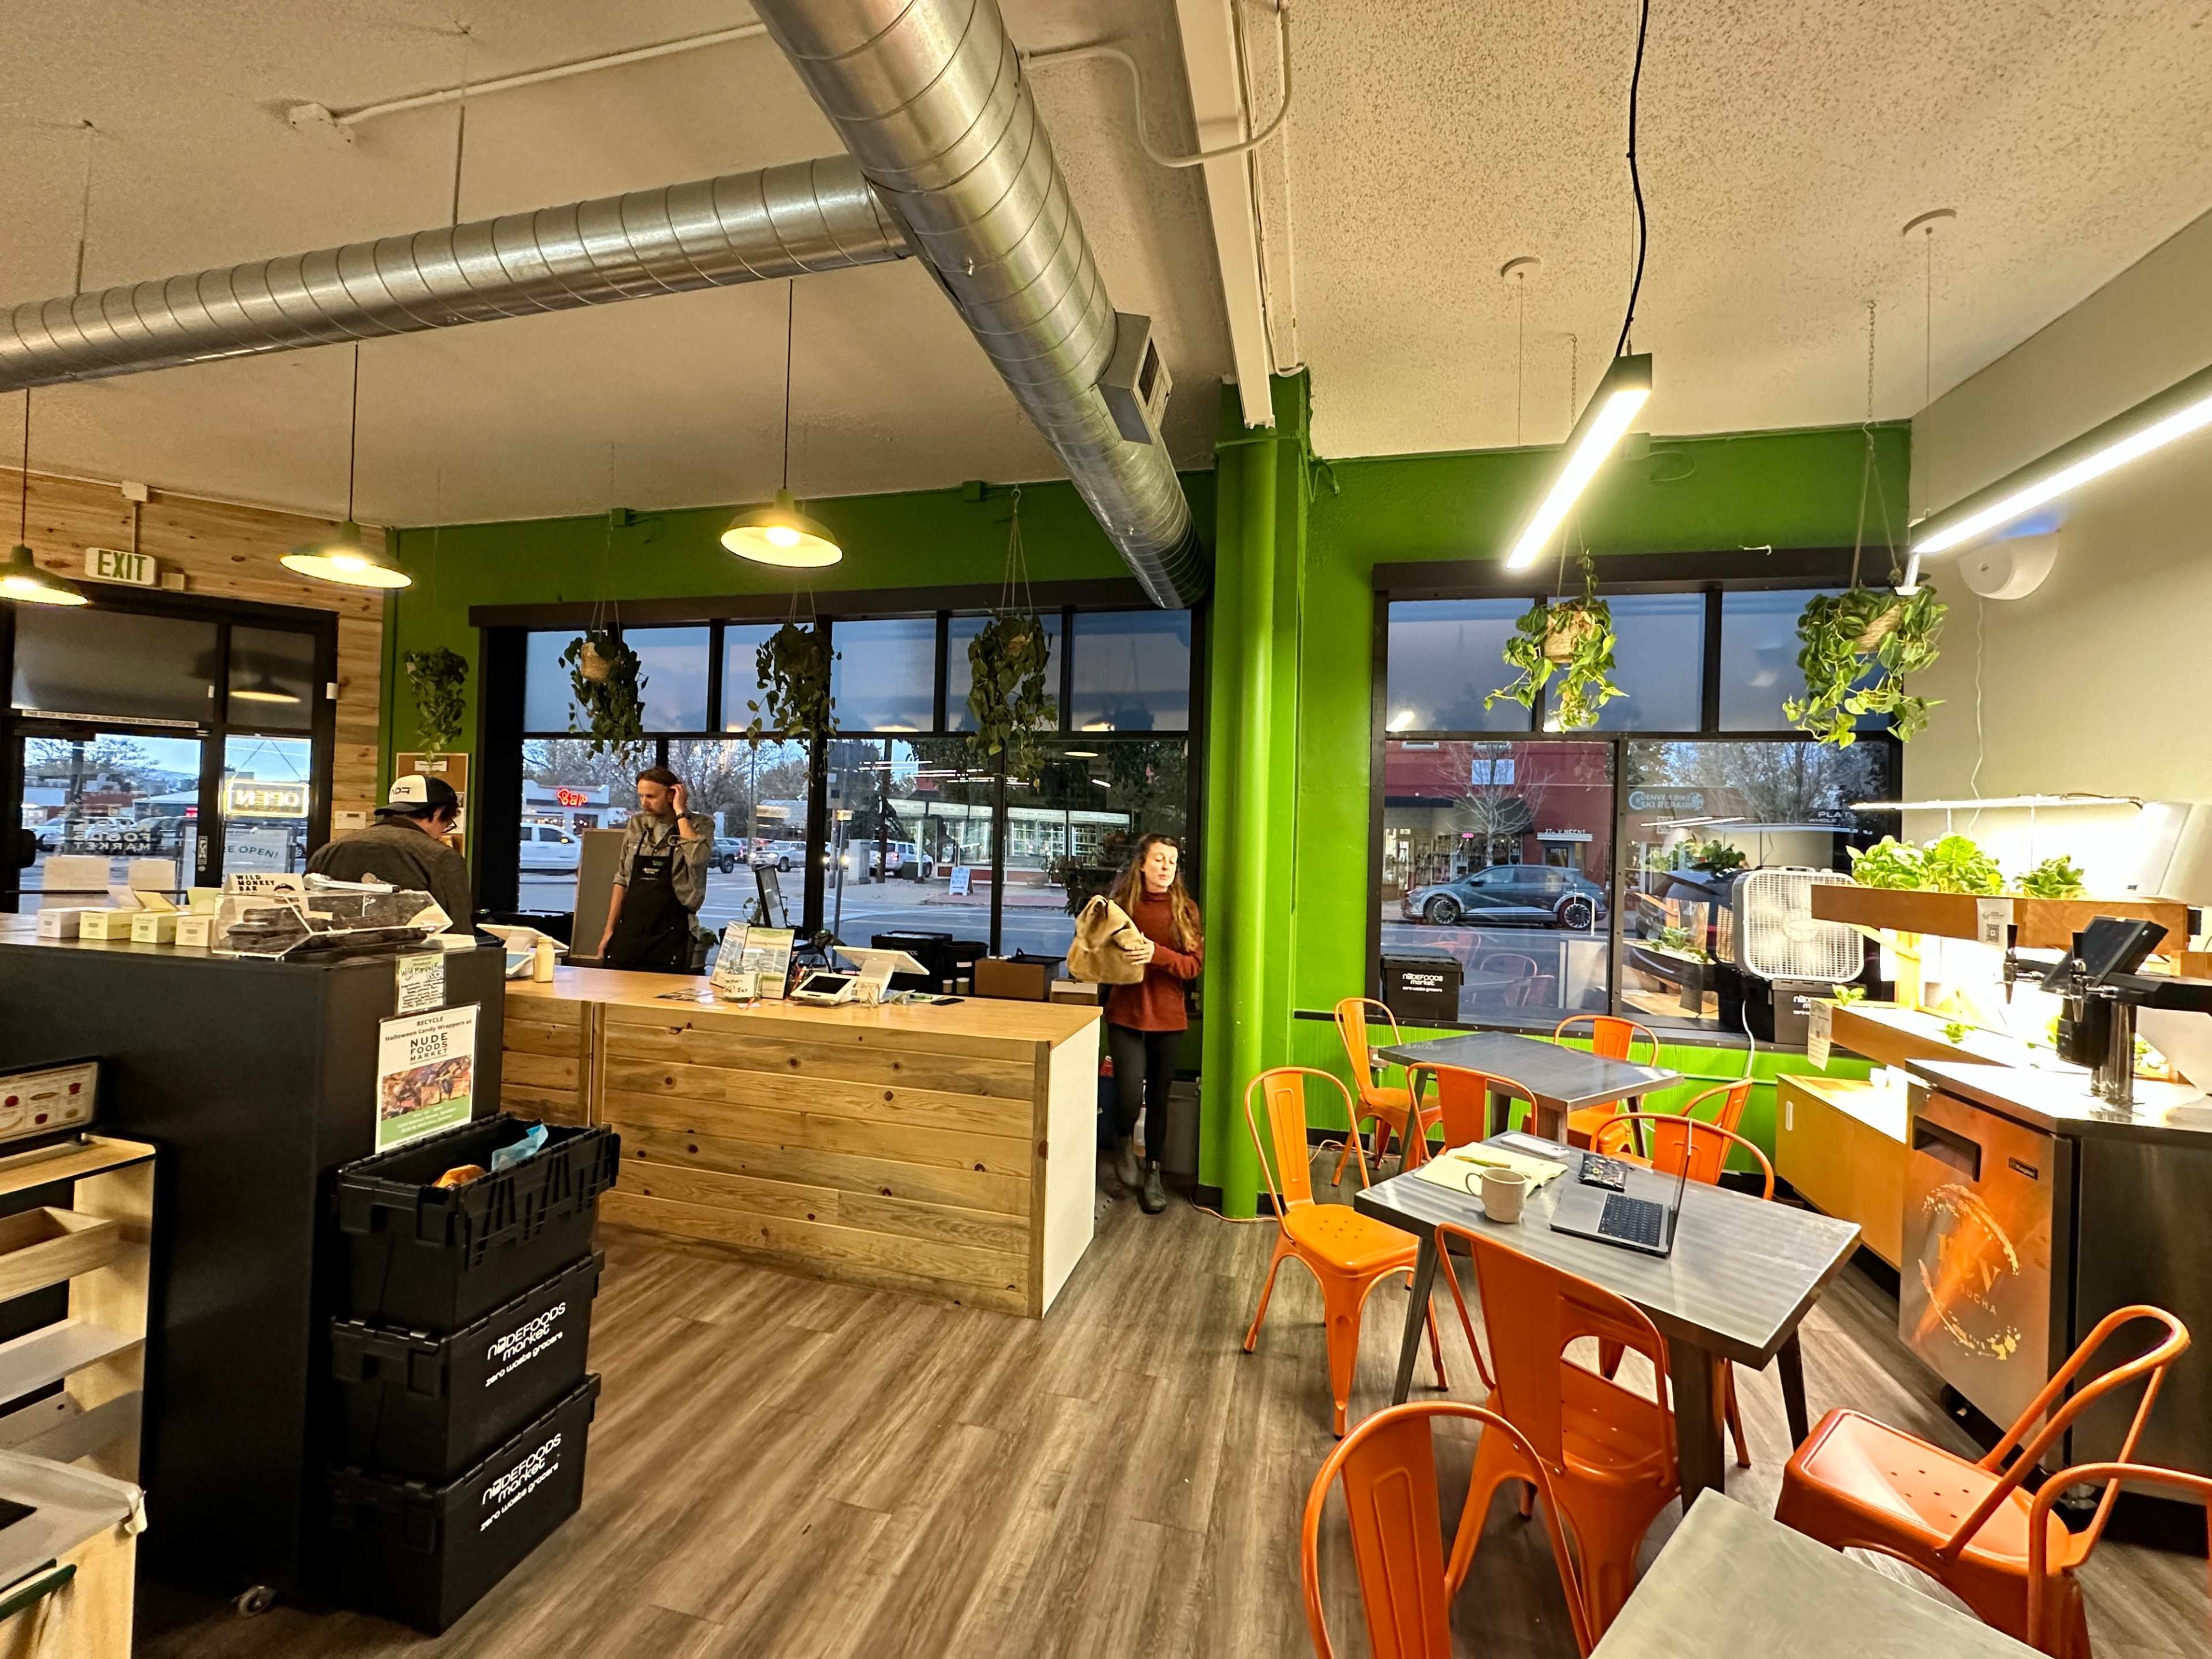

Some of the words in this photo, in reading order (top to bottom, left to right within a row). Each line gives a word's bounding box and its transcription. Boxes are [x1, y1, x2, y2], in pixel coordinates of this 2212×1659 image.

[97, 550, 147, 581] EXIT
[557, 789, 588, 806] Bar
[238, 846, 279, 859] OPEN!
[416, 1016, 444, 1027] RECYCLE
[385, 1030, 417, 1041] Halloween
[418, 1025, 437, 1035] Candy
[438, 1021, 465, 1030] Wrappers
[411, 1032, 448, 1048] NUDE
[410, 1041, 448, 1056] FOODS
[410, 1048, 448, 1062] MARKET
[502, 1323, 550, 1362] market
[485, 1368, 506, 1387] zero
[506, 1351, 532, 1373] waste
[532, 1331, 563, 1357] grocers
[498, 1457, 546, 1503] market
[480, 1510, 501, 1532] zero
[501, 1488, 527, 1513] waste
[528, 1463, 559, 1493] grocers
